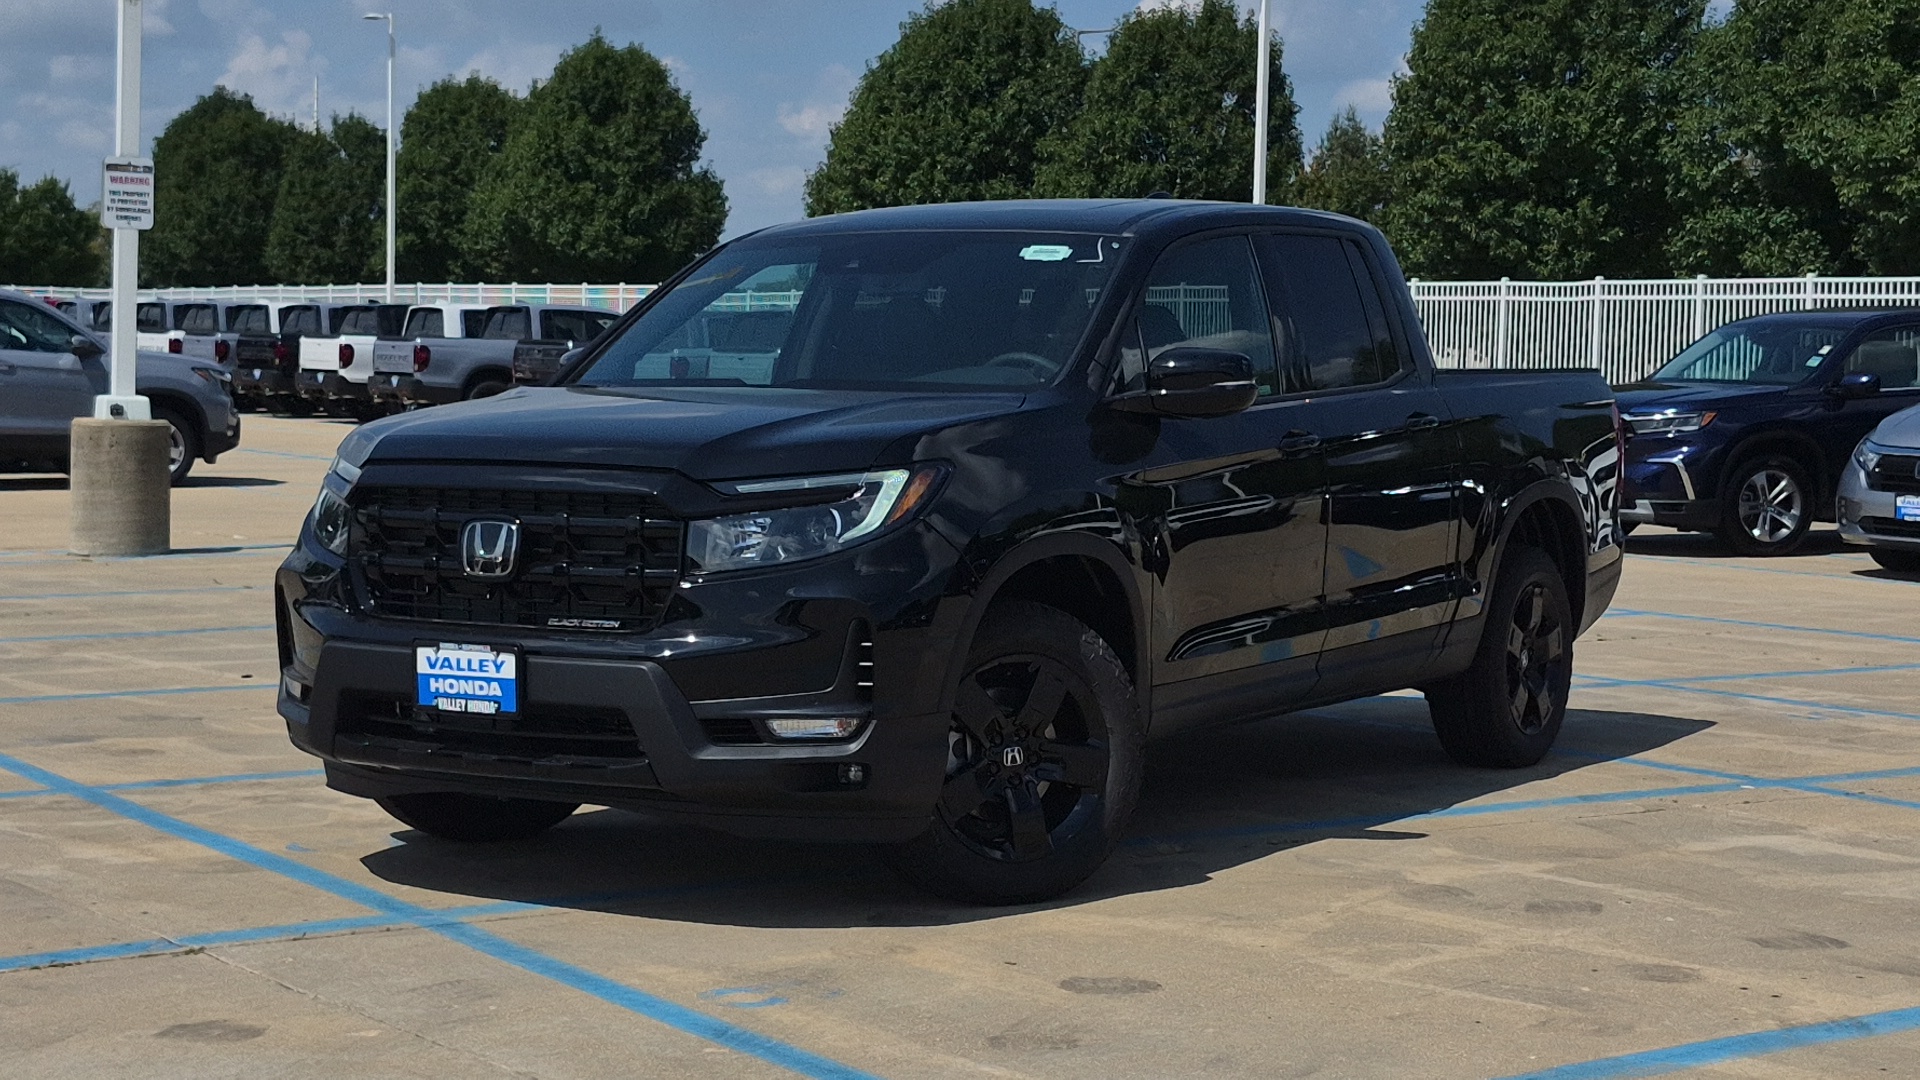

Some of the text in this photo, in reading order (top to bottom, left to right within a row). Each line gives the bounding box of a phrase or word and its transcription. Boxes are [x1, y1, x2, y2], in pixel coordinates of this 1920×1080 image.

[110, 176, 150, 186] WARNING
[426, 656, 506, 674] VALLEY
[430, 678, 502, 696] HONDA
[438, 698, 496, 714] VALLEY HONDA
